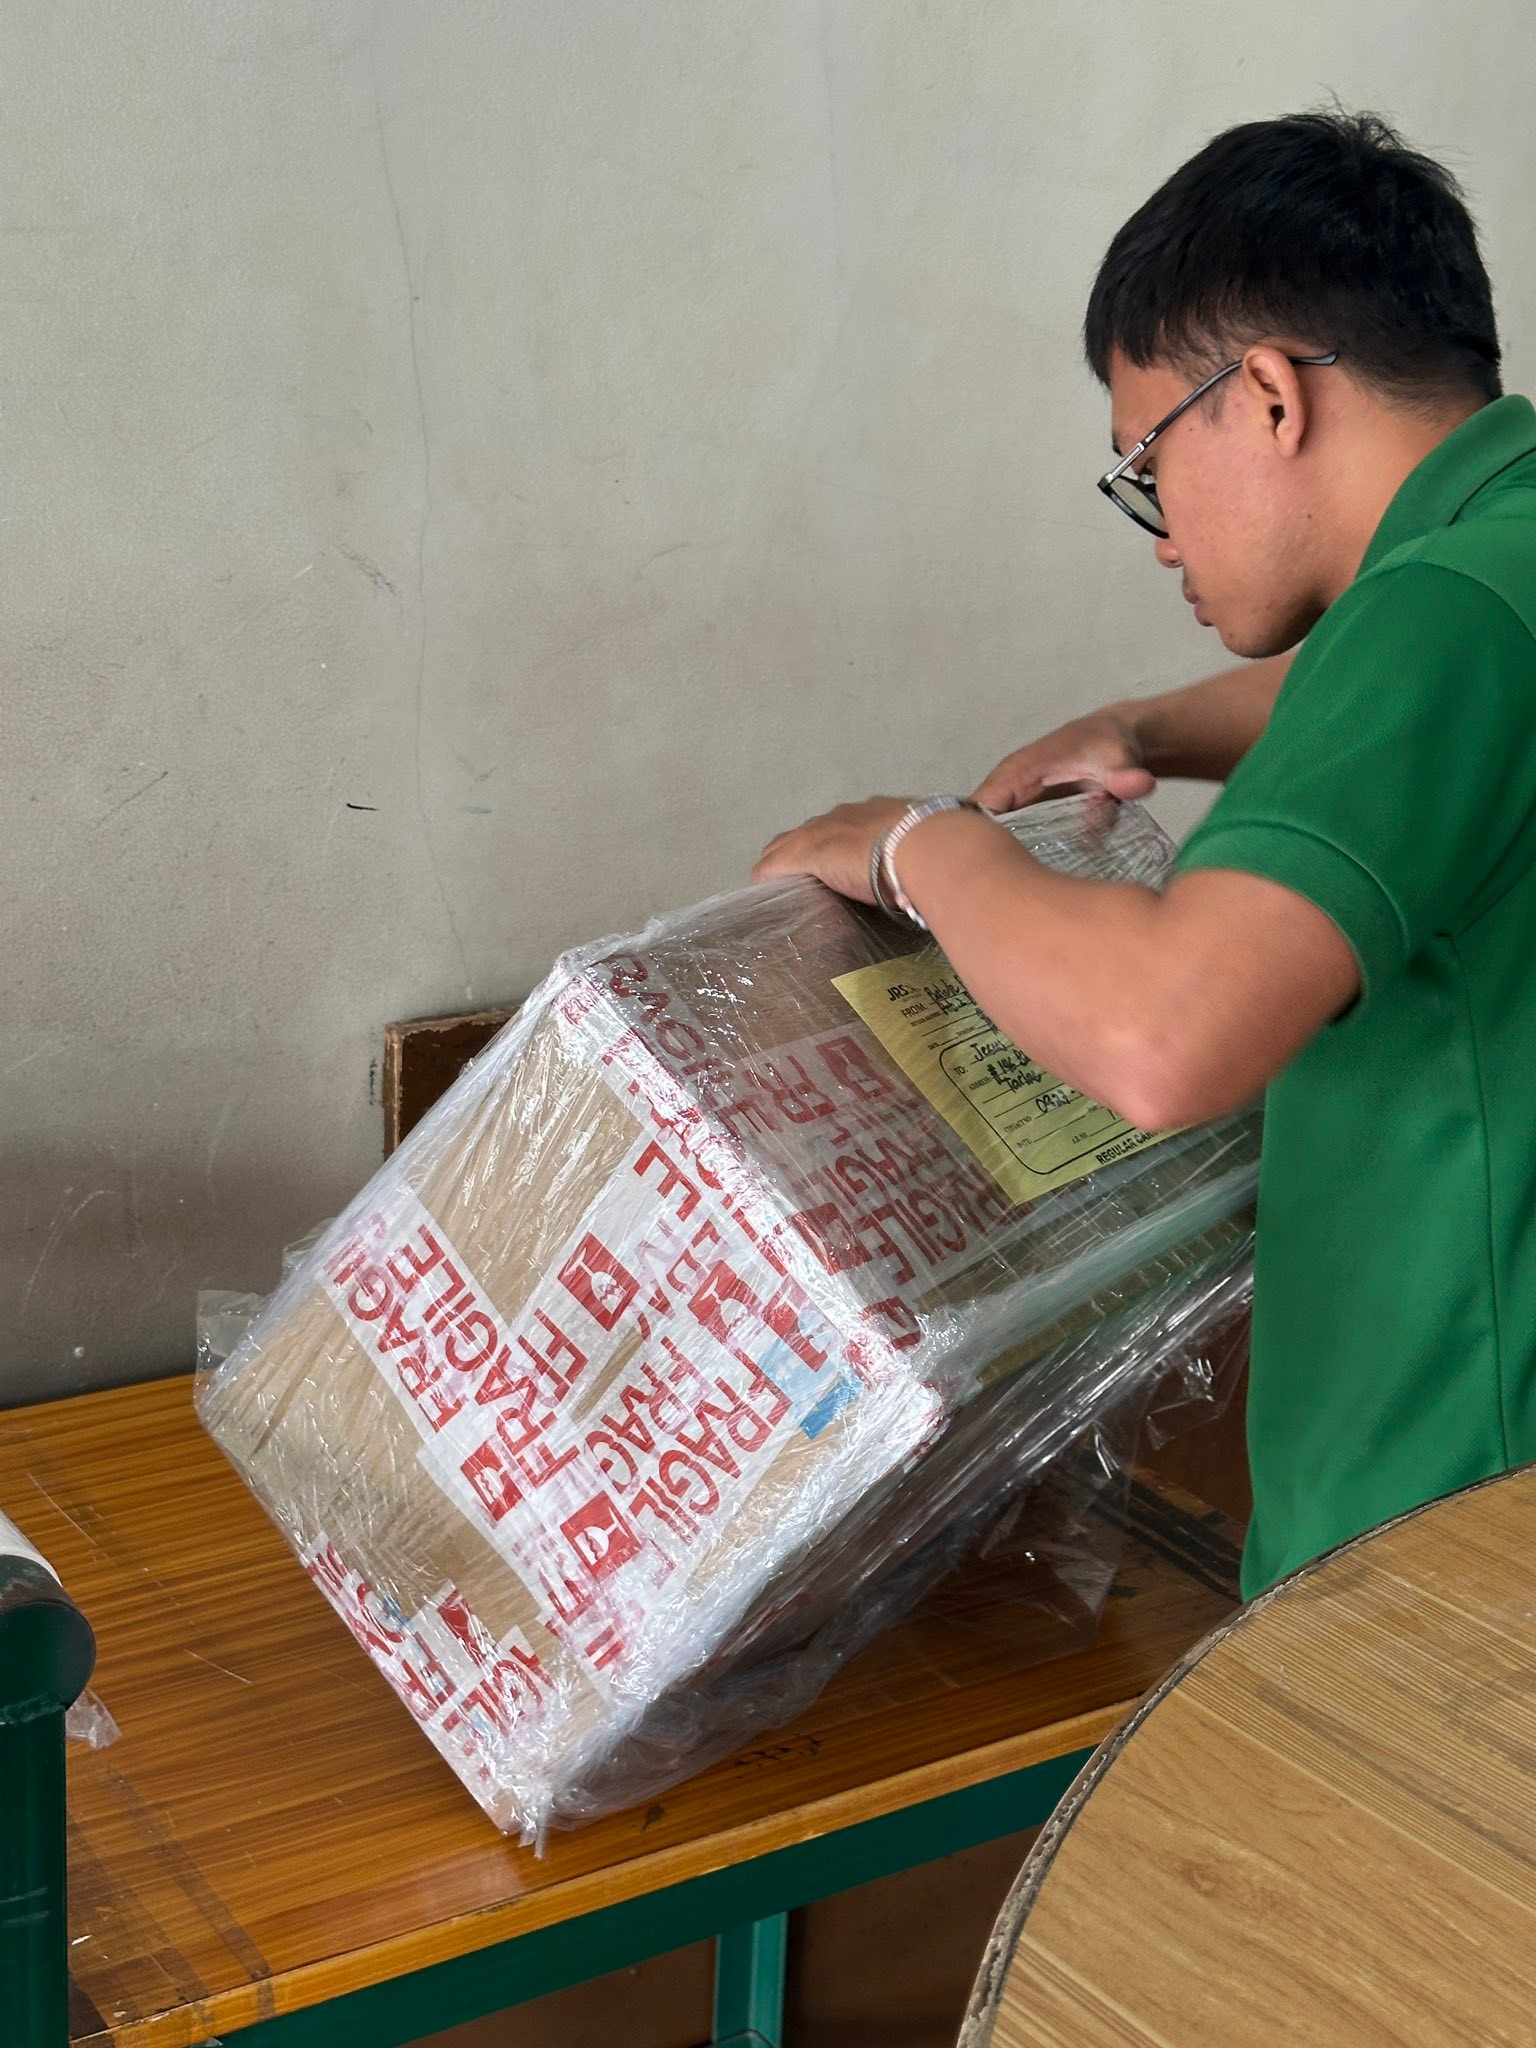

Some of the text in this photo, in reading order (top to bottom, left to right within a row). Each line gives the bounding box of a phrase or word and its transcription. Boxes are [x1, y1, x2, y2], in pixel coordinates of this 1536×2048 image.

[886, 984, 911, 1002] JRS
[901, 1002, 928, 1018] FROM:
[953, 1064, 968, 1077] TO:
[1095, 1139, 1133, 1165] REGULAR
[860, 1162, 1032, 1286] RAGILE
[388, 1224, 580, 1488] FRAGILE
[585, 1336, 714, 1495] FRAG
[628, 1346, 793, 1546] FRAGIL
